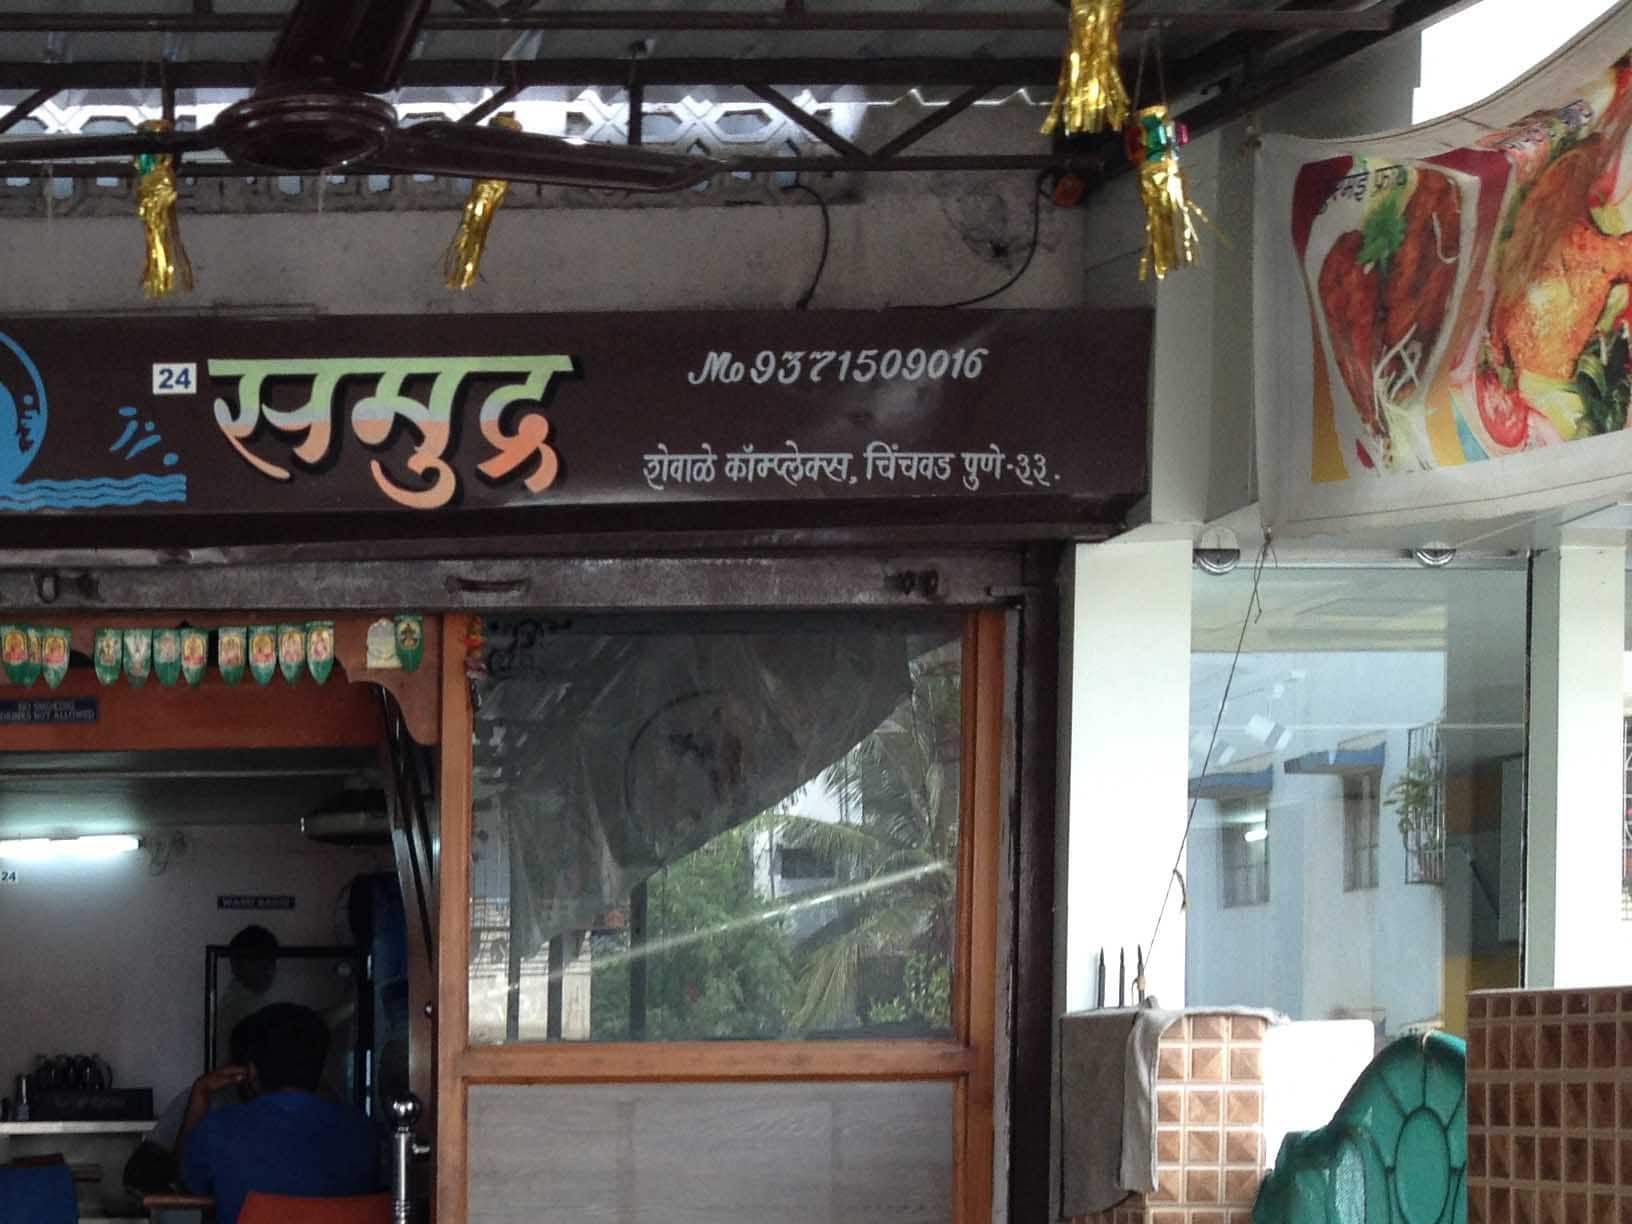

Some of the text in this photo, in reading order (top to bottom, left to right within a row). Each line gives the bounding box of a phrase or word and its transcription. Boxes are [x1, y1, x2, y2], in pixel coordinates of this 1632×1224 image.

[158, 368, 192, 389] 24
[750, 348, 989, 384] 9371509016
[208, 355, 574, 509] समुद्र
[643, 443, 718, 490] शेवाळे
[864, 441, 956, 481] चिंचवड
[1, 871, 16, 881] 24
